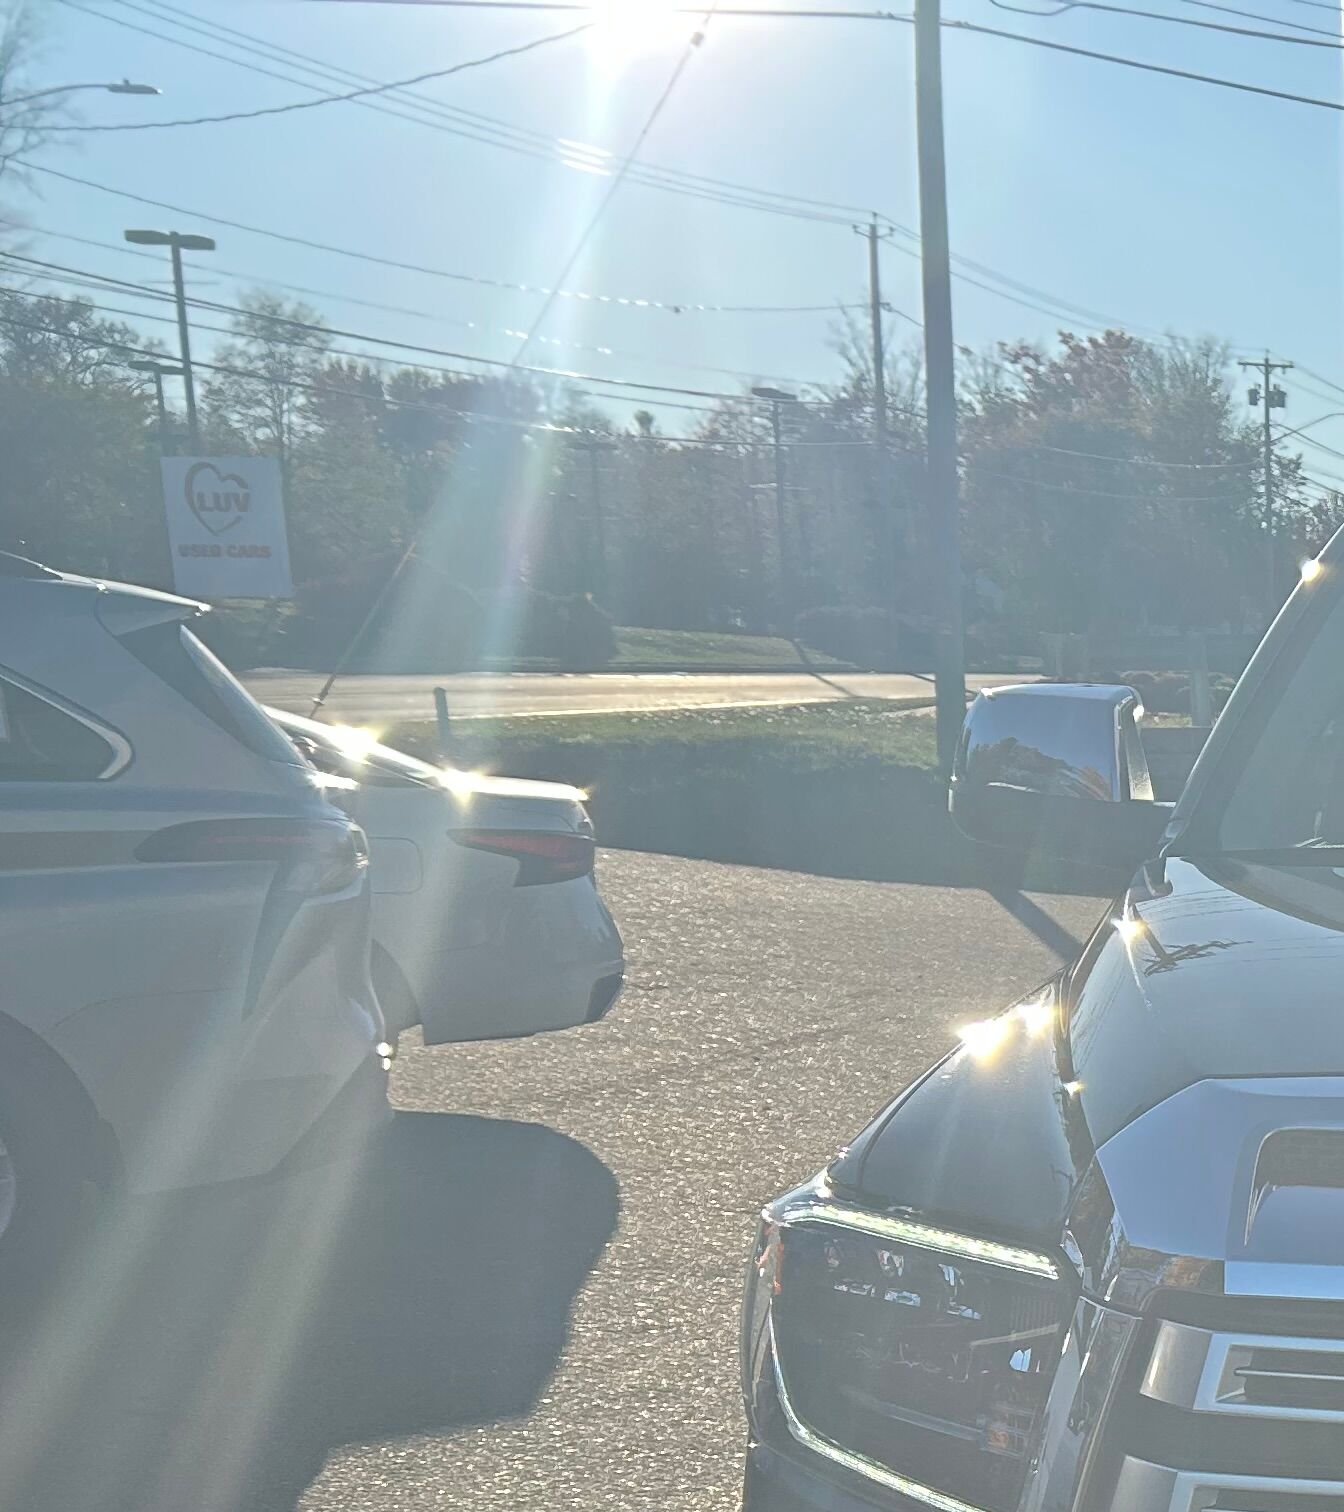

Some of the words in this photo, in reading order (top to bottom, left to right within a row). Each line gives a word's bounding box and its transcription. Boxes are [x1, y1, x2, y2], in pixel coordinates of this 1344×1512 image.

[197, 491, 251, 513] LUV
[177, 543, 222, 558] USED
[227, 543, 272, 558] CARS
